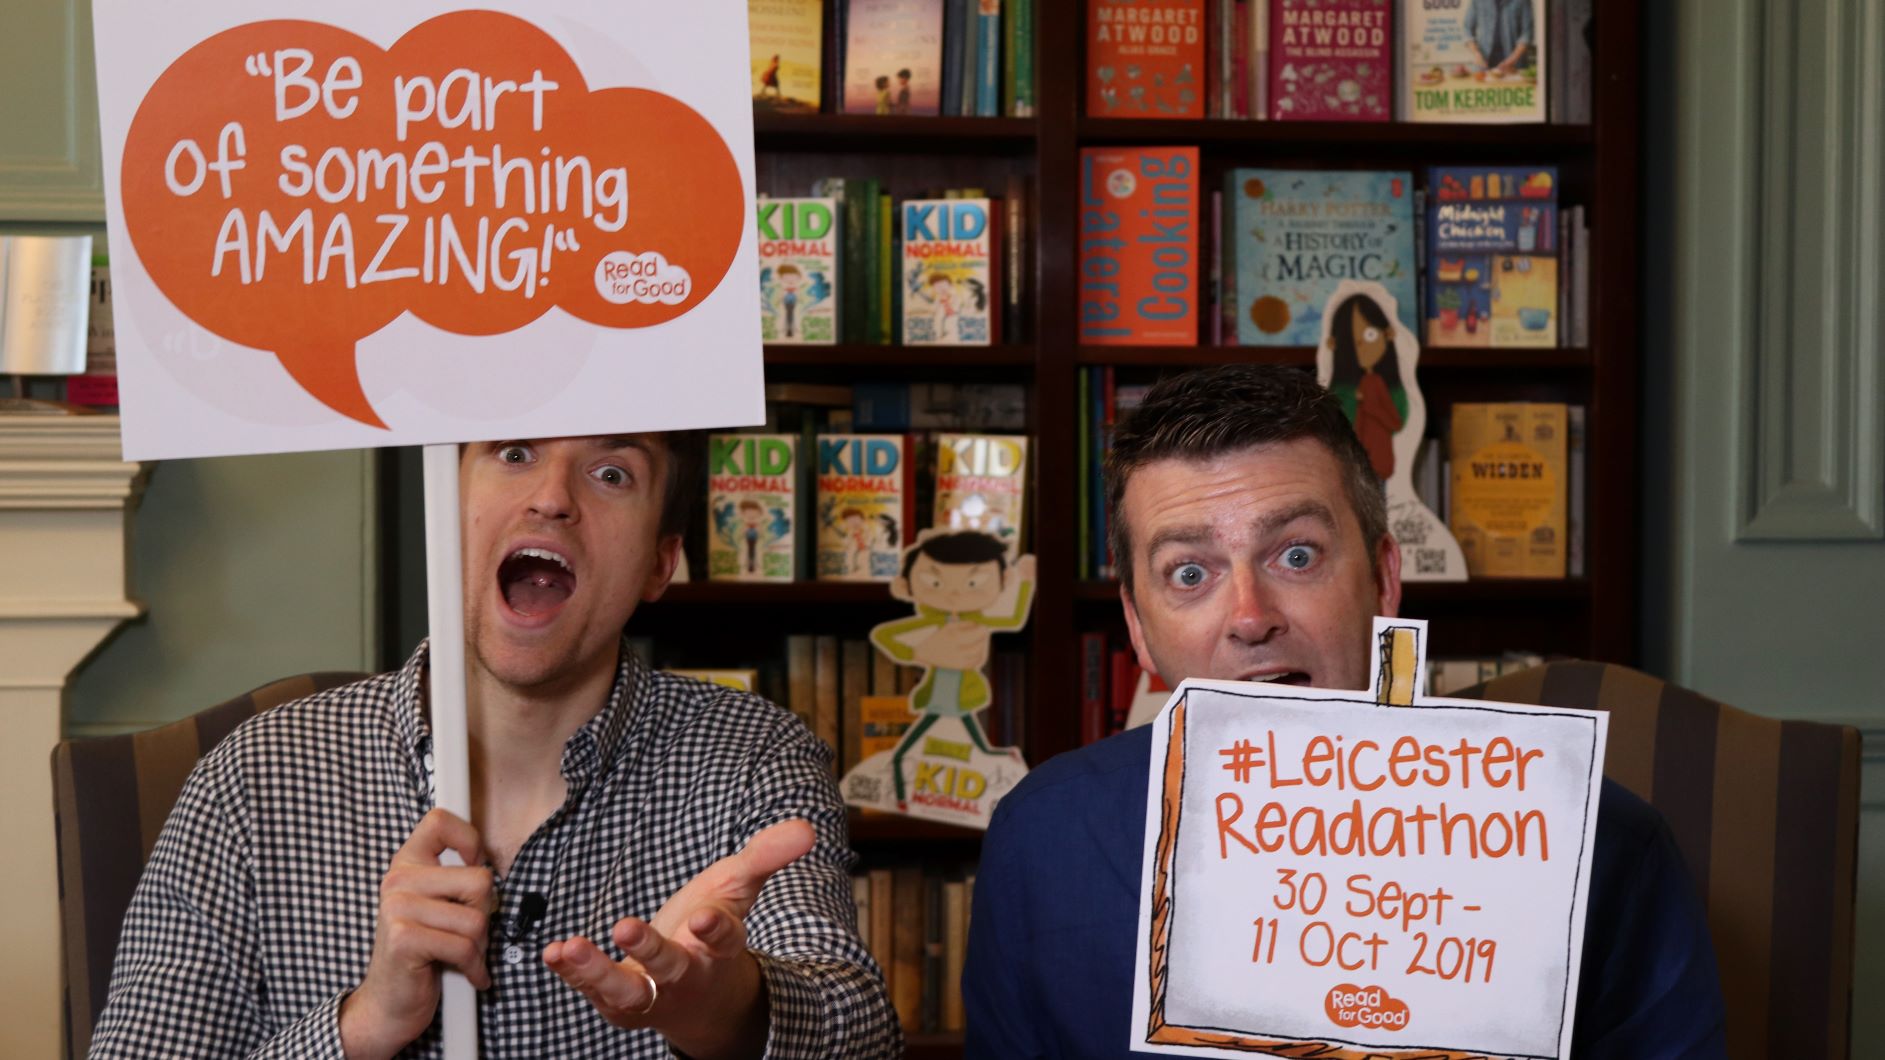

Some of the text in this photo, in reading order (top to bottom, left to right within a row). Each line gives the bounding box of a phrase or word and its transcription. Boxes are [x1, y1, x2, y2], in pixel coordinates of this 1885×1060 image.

[1097, 7, 1199, 25] MARGARET
[1283, 10, 1385, 27] MARGARET
[1097, 24, 1199, 44] ATWOOD
[1282, 27, 1385, 46] ATWOOD
[394, 68, 559, 141] part
[1415, 86, 1535, 110] TOM KERRIDGE
[278, 141, 628, 232] something
[1260, 201, 1393, 217] HARRY POTTER
[906, 203, 986, 241] KID
[760, 242, 832, 257] ORMAL
[1136, 155, 1192, 320] Cooking
[1285, 232, 1368, 251] HISTORY
[905, 242, 987, 258] NORMAL
[604, 256, 657, 281] Read
[1276, 253, 1382, 281] MAGIC
[612, 278, 685, 297] for Good
[711, 438, 792, 476] KID
[819, 438, 899, 476] KID
[940, 438, 1022, 477] KID
[1471, 462, 1544, 480] WISDEN
[711, 477, 792, 493] NORMAL
[819, 477, 899, 493] NORMAL
[1219, 731, 1544, 791] #Leicester
[914, 760, 988, 800] KID
[912, 790, 981, 816] NORMAL
[1215, 792, 1549, 861] Readathon
[1273, 868, 1327, 916] 30
[1252, 917, 1496, 983] 11 Oct 2019
[1332, 989, 1381, 1009] Read
[1338, 1007, 1406, 1025] for Good
